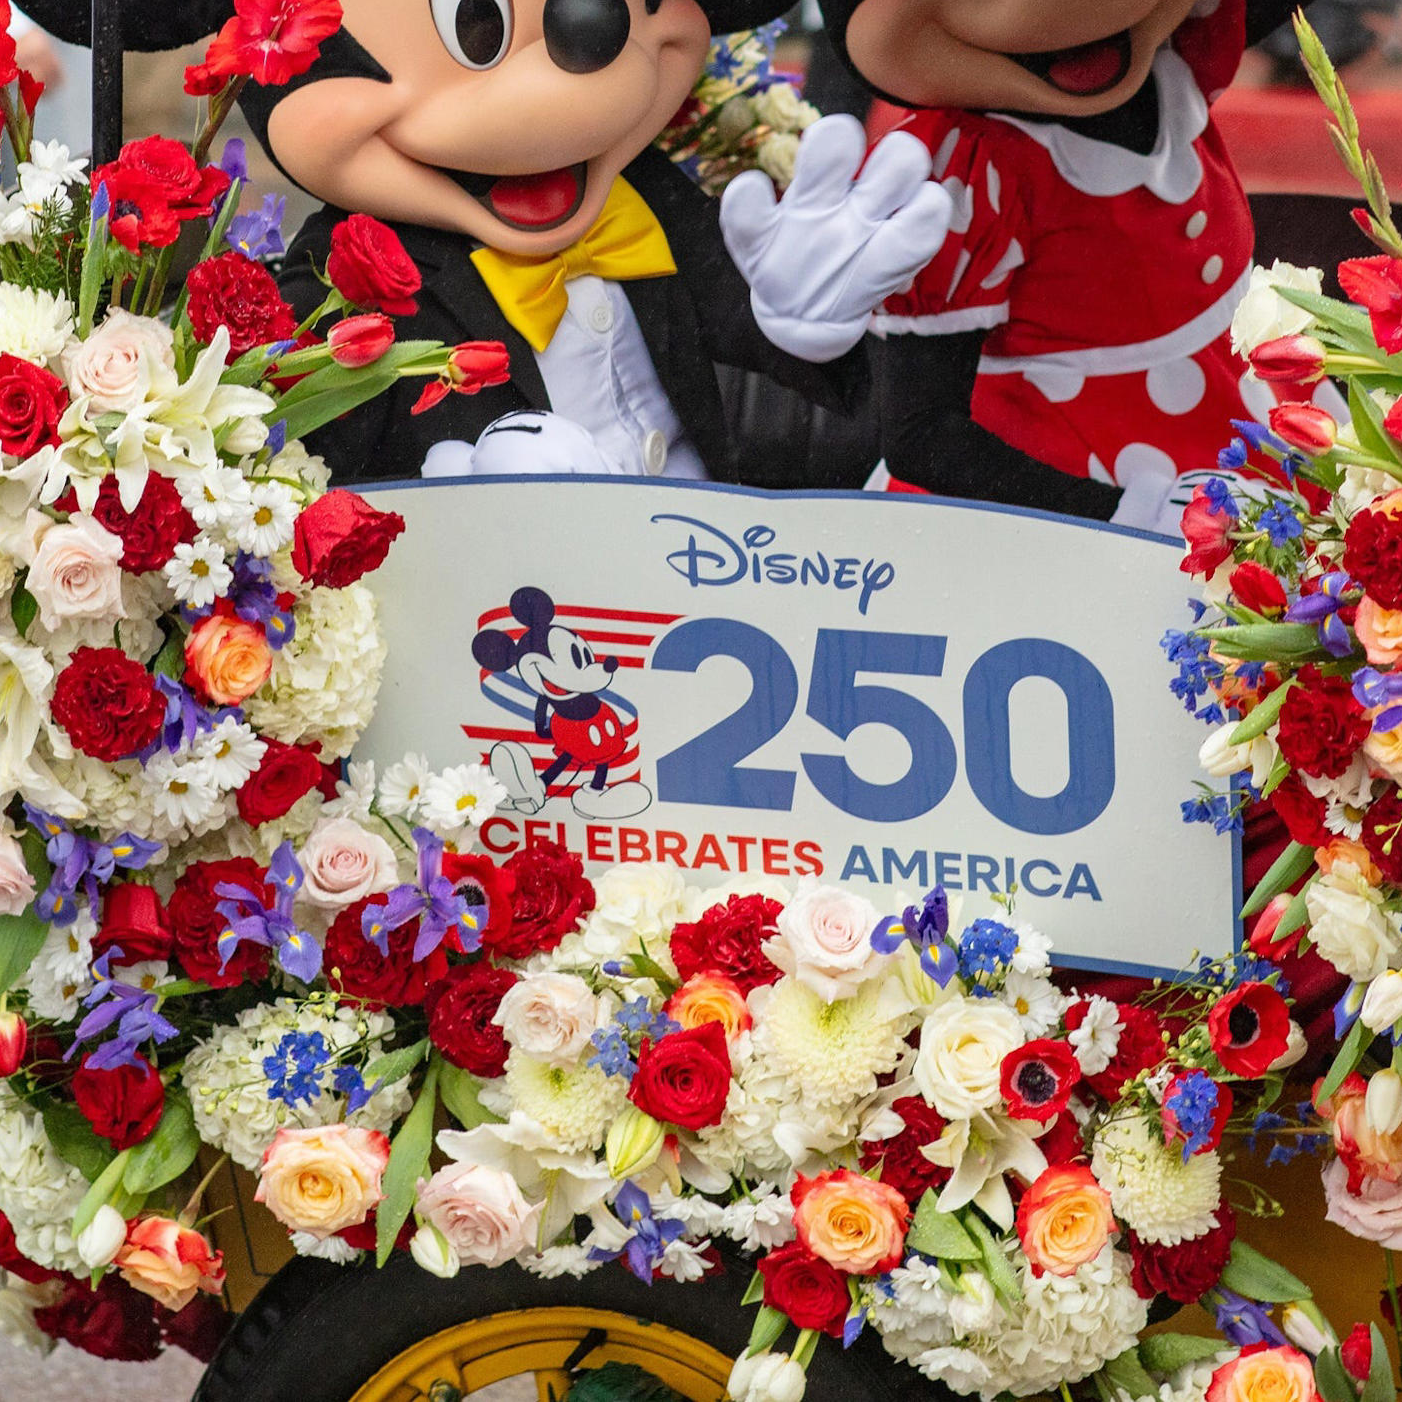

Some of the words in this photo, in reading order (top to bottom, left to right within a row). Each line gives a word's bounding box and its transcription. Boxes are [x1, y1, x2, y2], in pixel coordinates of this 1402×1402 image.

[650, 616, 1116, 836] 250
[479, 816, 825, 878] CELEBRATES
[839, 844, 1103, 901] AMERICA
